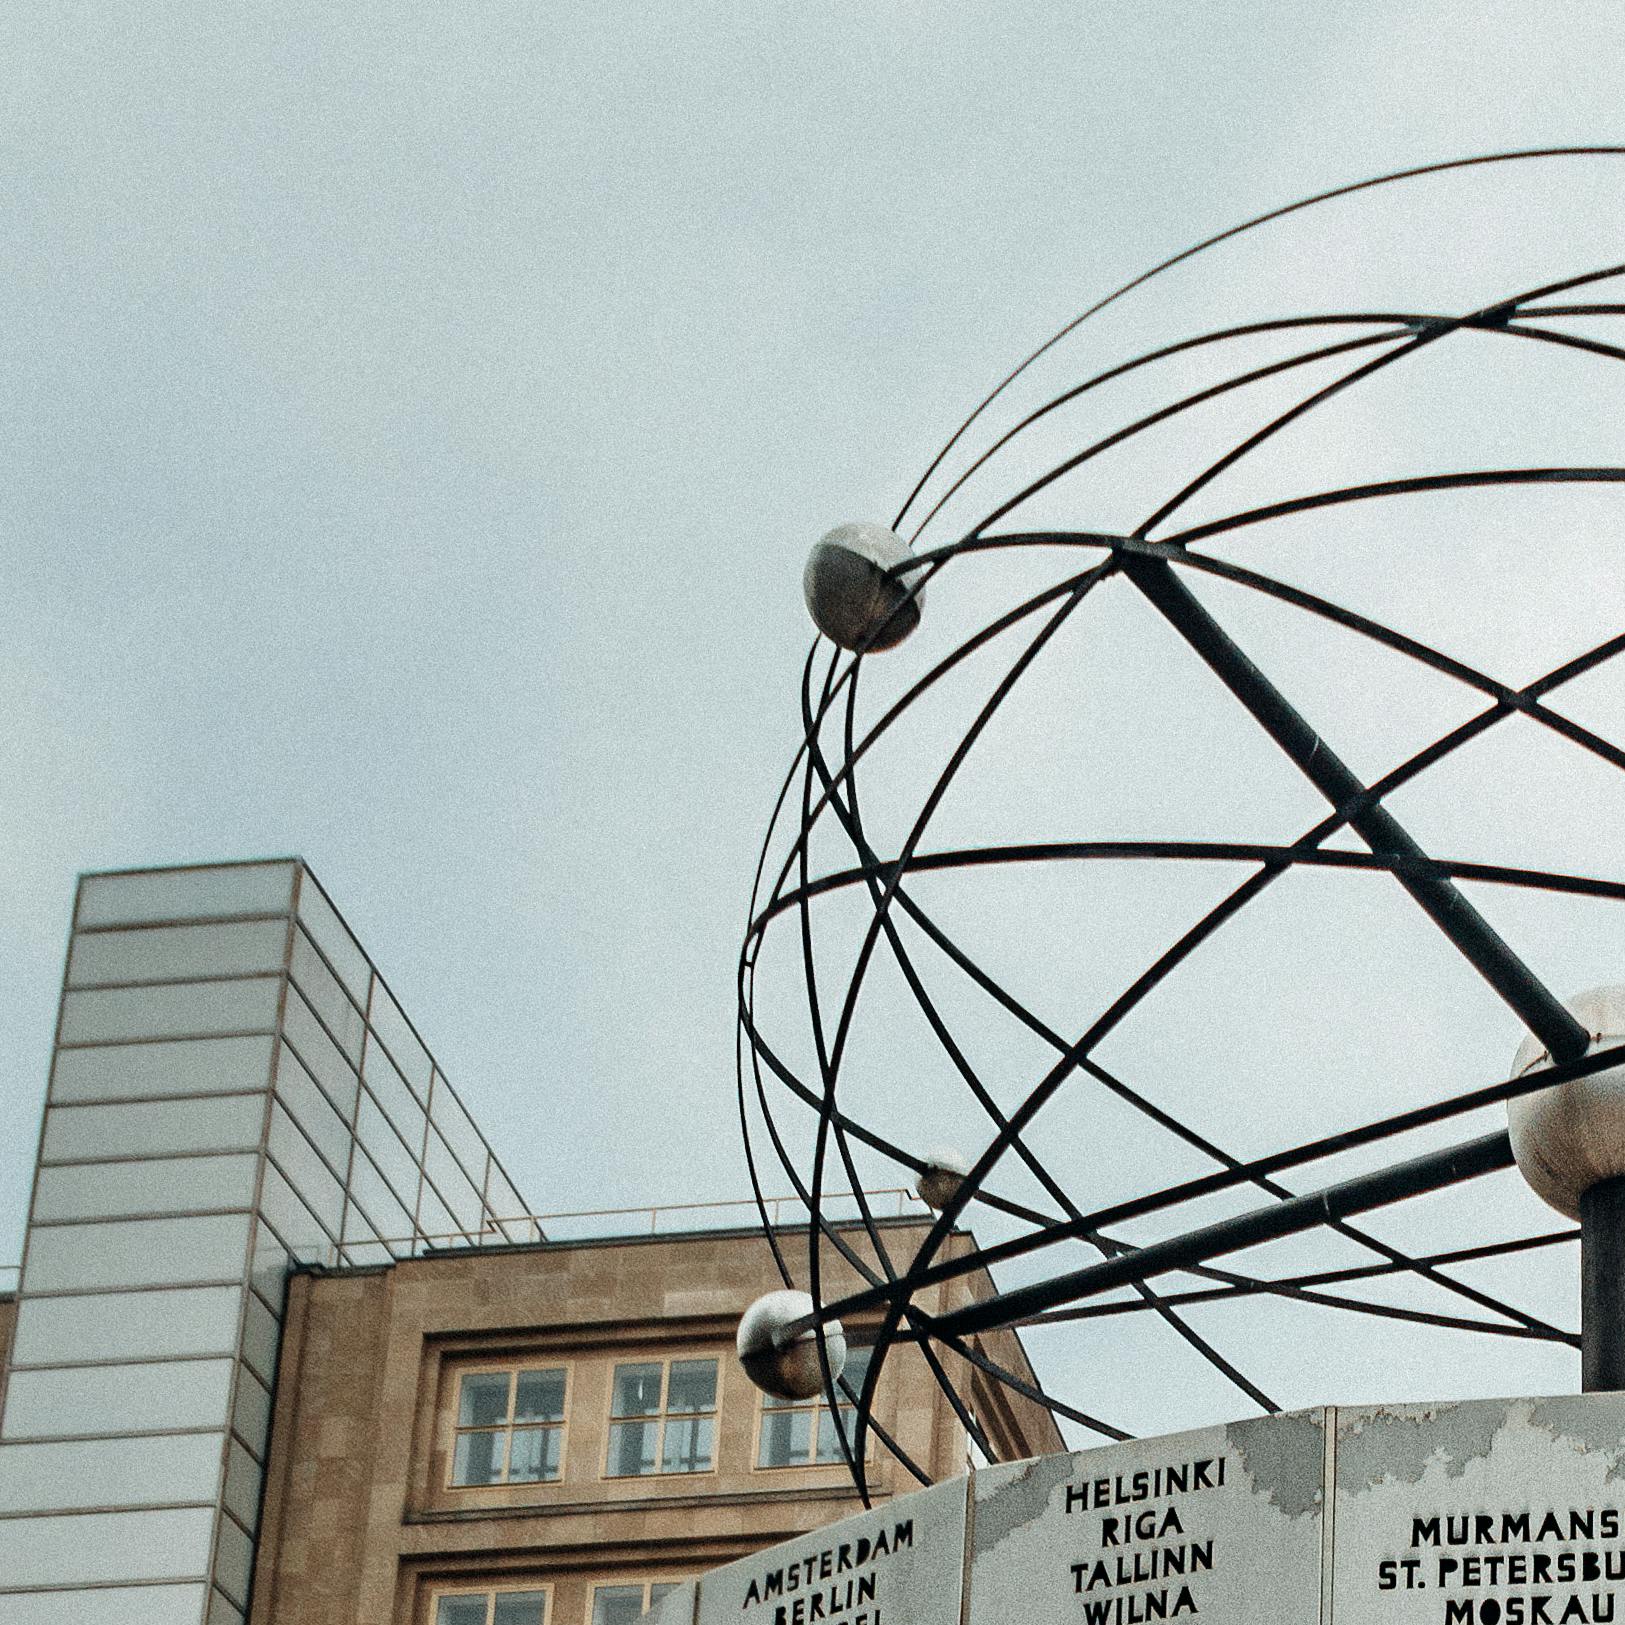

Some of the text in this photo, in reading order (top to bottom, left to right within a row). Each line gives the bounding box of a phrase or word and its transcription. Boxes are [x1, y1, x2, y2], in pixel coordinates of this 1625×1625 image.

[1065, 1457, 1226, 1514] HELSINKI
[1101, 1506, 1184, 1548] RIGA
[743, 1519, 913, 1609] AMSTERDAM
[1070, 1540, 1214, 1593] TALLINN
[1378, 1559, 1426, 1590] ST.
